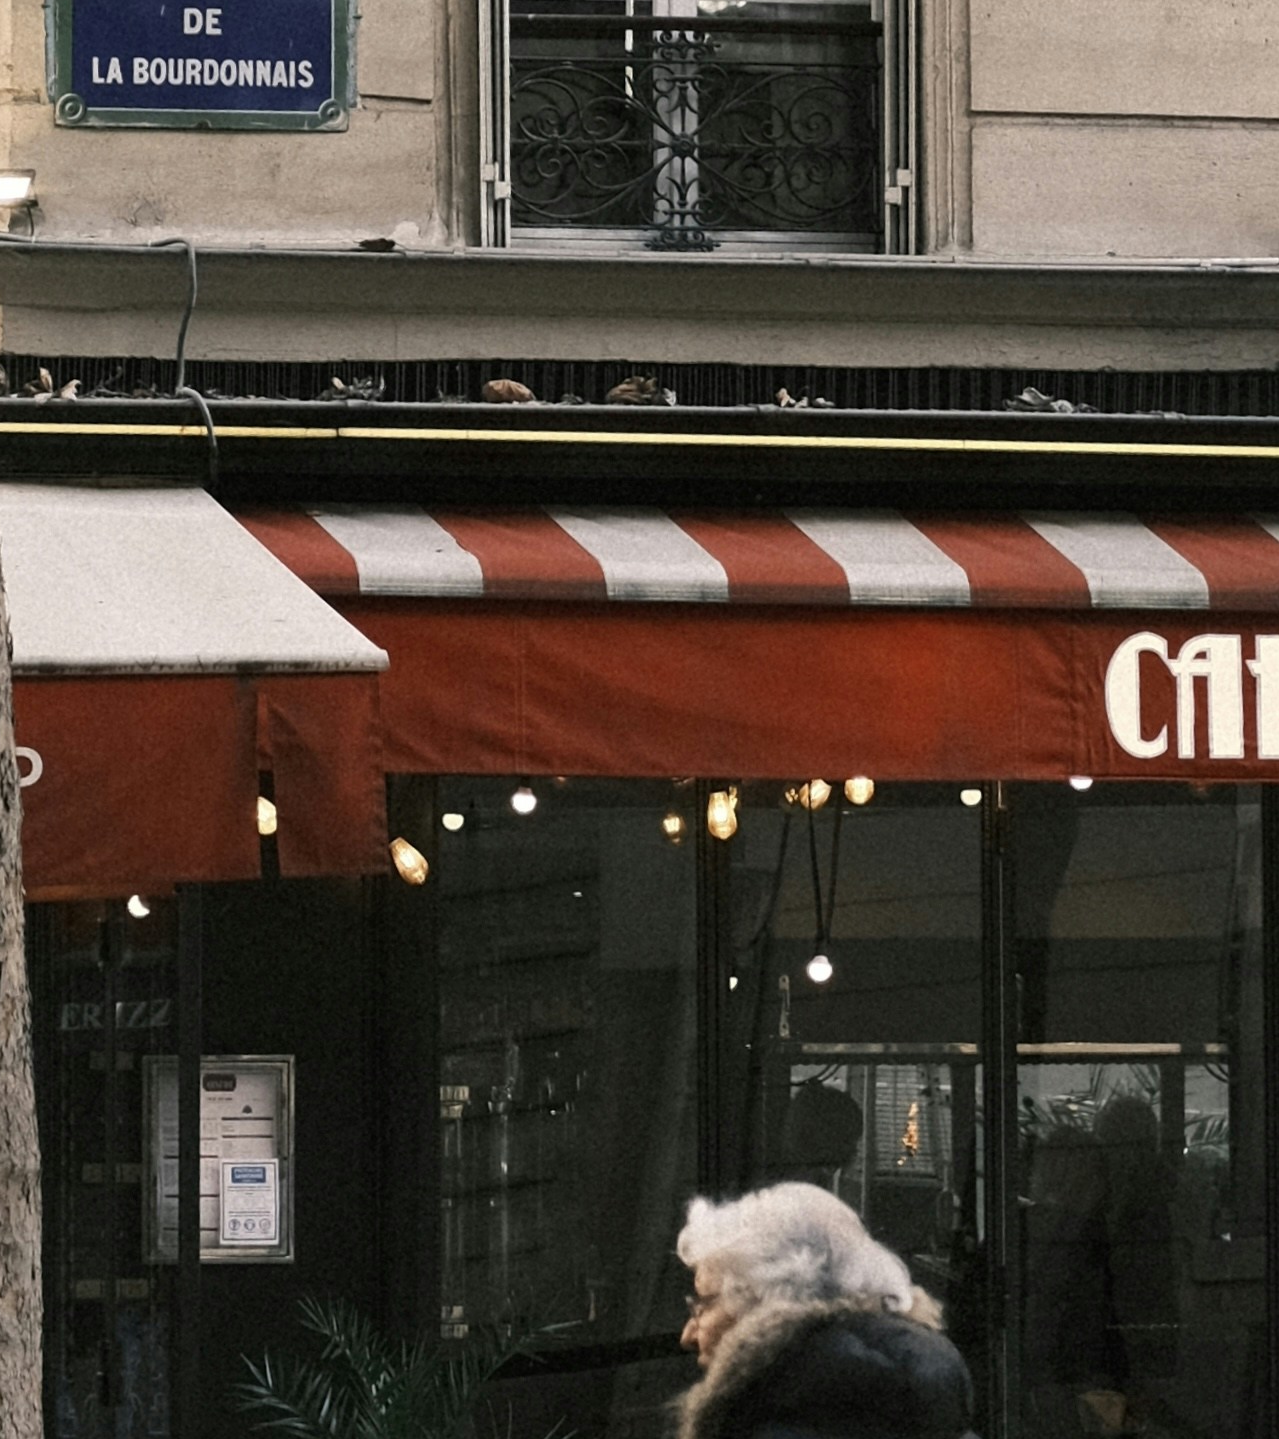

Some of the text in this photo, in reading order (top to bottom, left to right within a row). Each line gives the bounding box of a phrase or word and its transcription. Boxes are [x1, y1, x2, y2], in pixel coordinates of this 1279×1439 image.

[182, 7, 223, 36] DE
[91, 56, 315, 88] LA BOURDONNAIS
